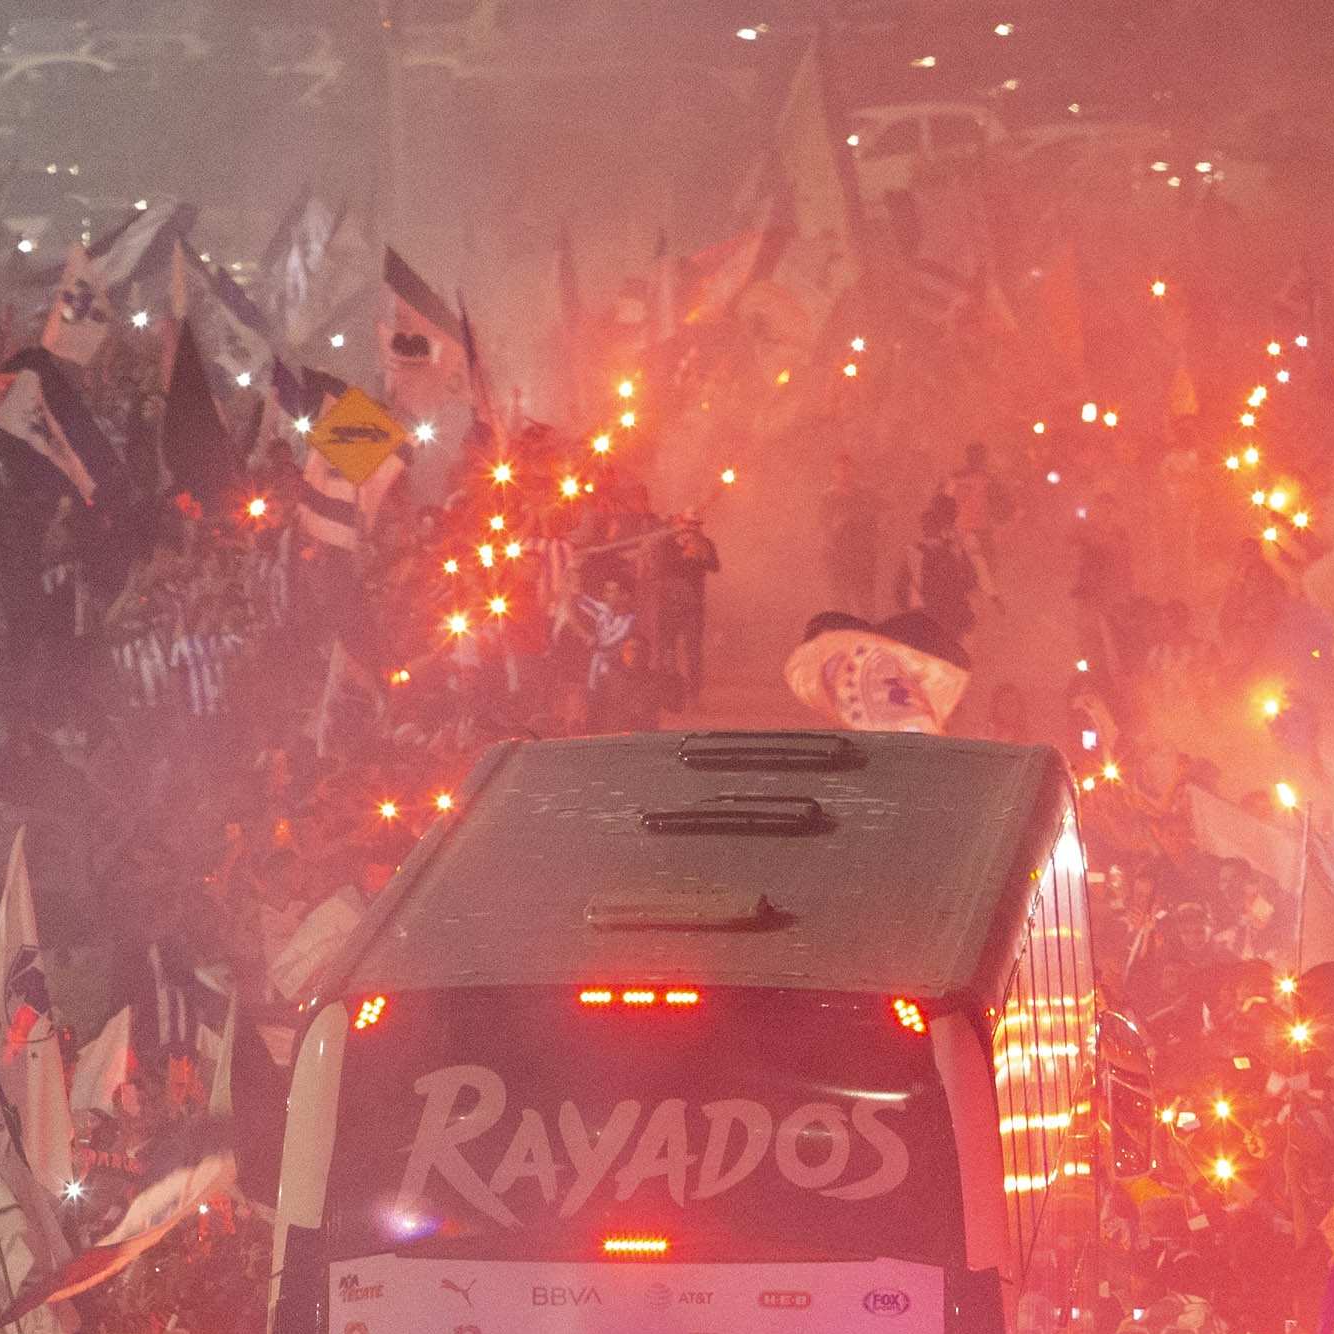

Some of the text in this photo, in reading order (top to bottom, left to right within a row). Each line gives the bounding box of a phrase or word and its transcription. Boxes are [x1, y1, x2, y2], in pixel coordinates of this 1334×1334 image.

[395, 1064, 910, 1230] RAYADOS
[532, 1286, 602, 1306] BBVA
[678, 1292, 714, 1305] AT&T
[873, 1294, 900, 1306] FOX
